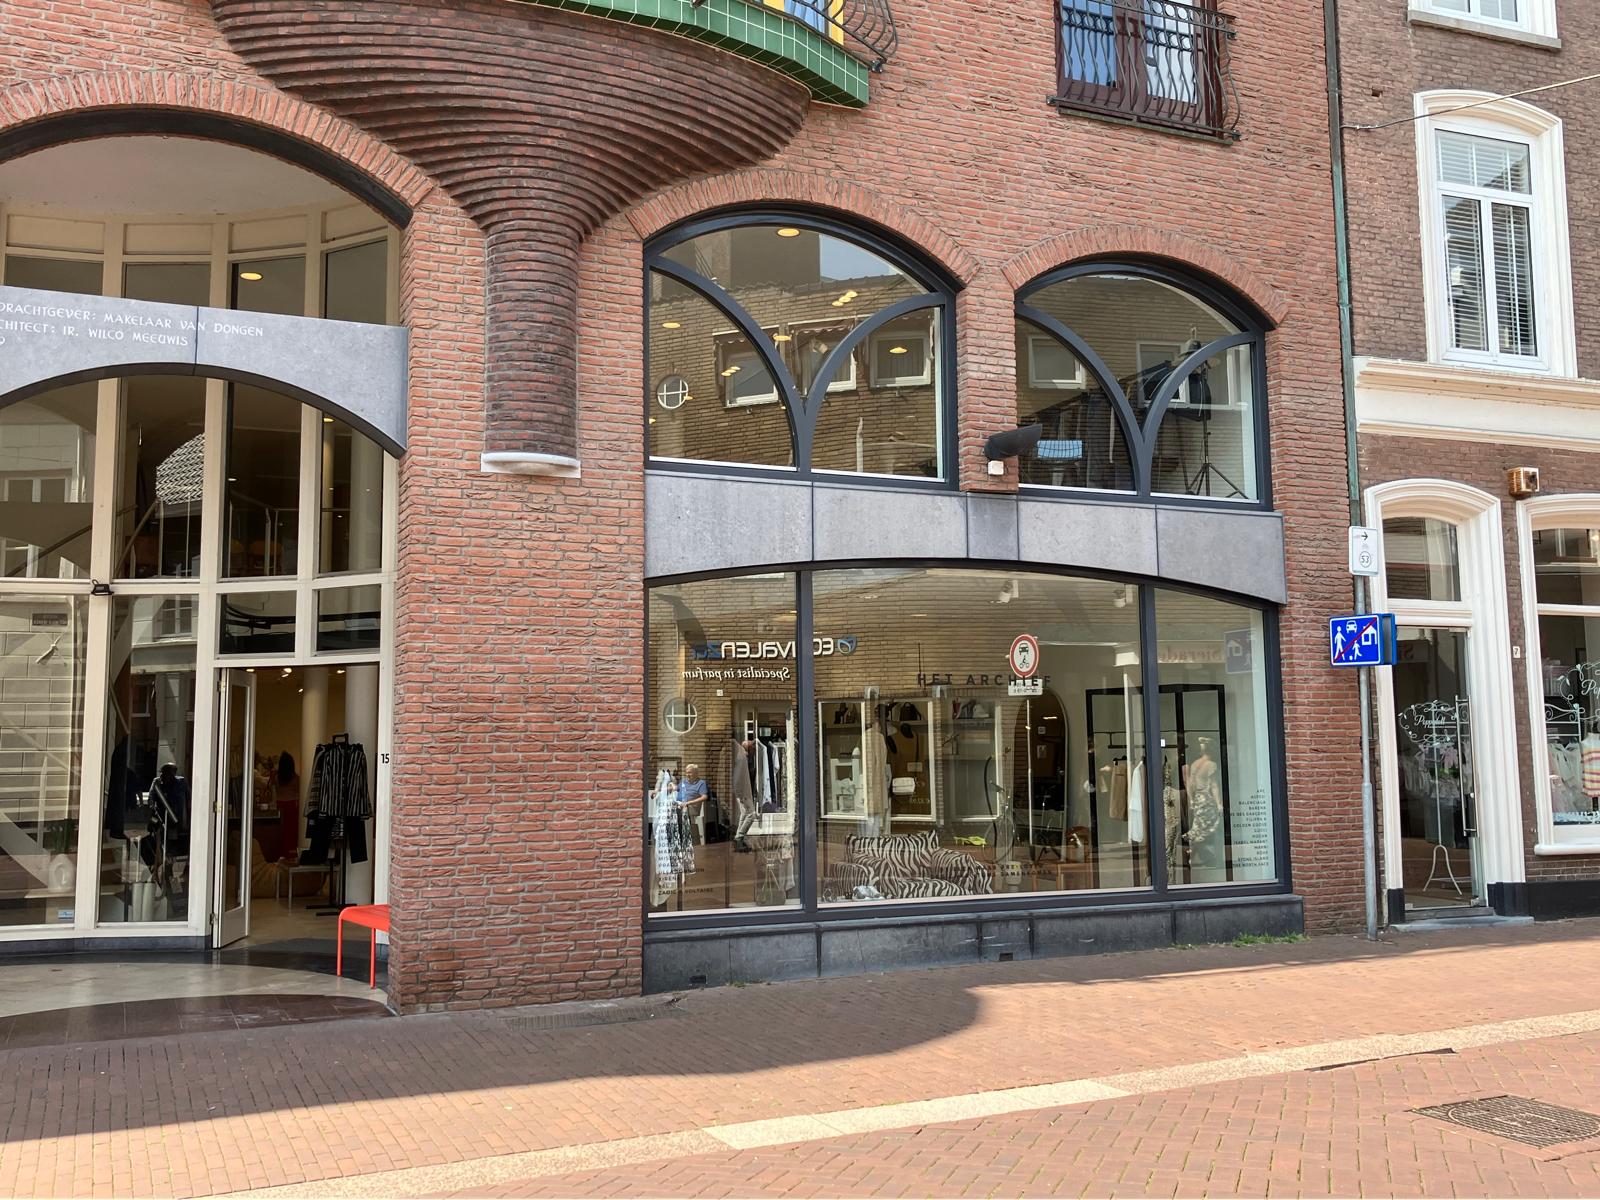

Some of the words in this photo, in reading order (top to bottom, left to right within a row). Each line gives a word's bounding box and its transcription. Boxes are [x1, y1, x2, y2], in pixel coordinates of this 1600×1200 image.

[104, 312, 172, 329] MAKELAAR
[180, 319, 206, 331] VAN
[213, 321, 263, 337] DONGEN
[63, 325, 79, 337] IR.
[88, 327, 125, 341] WILCO
[131, 331, 189, 346] MEEUWIS
[1360, 554, 1371, 564] 53
[1513, 647, 1519, 656] 7
[916, 673, 953, 687] HET
[966, 673, 1052, 688] ARCHIEF
[380, 753, 390, 764] 15
